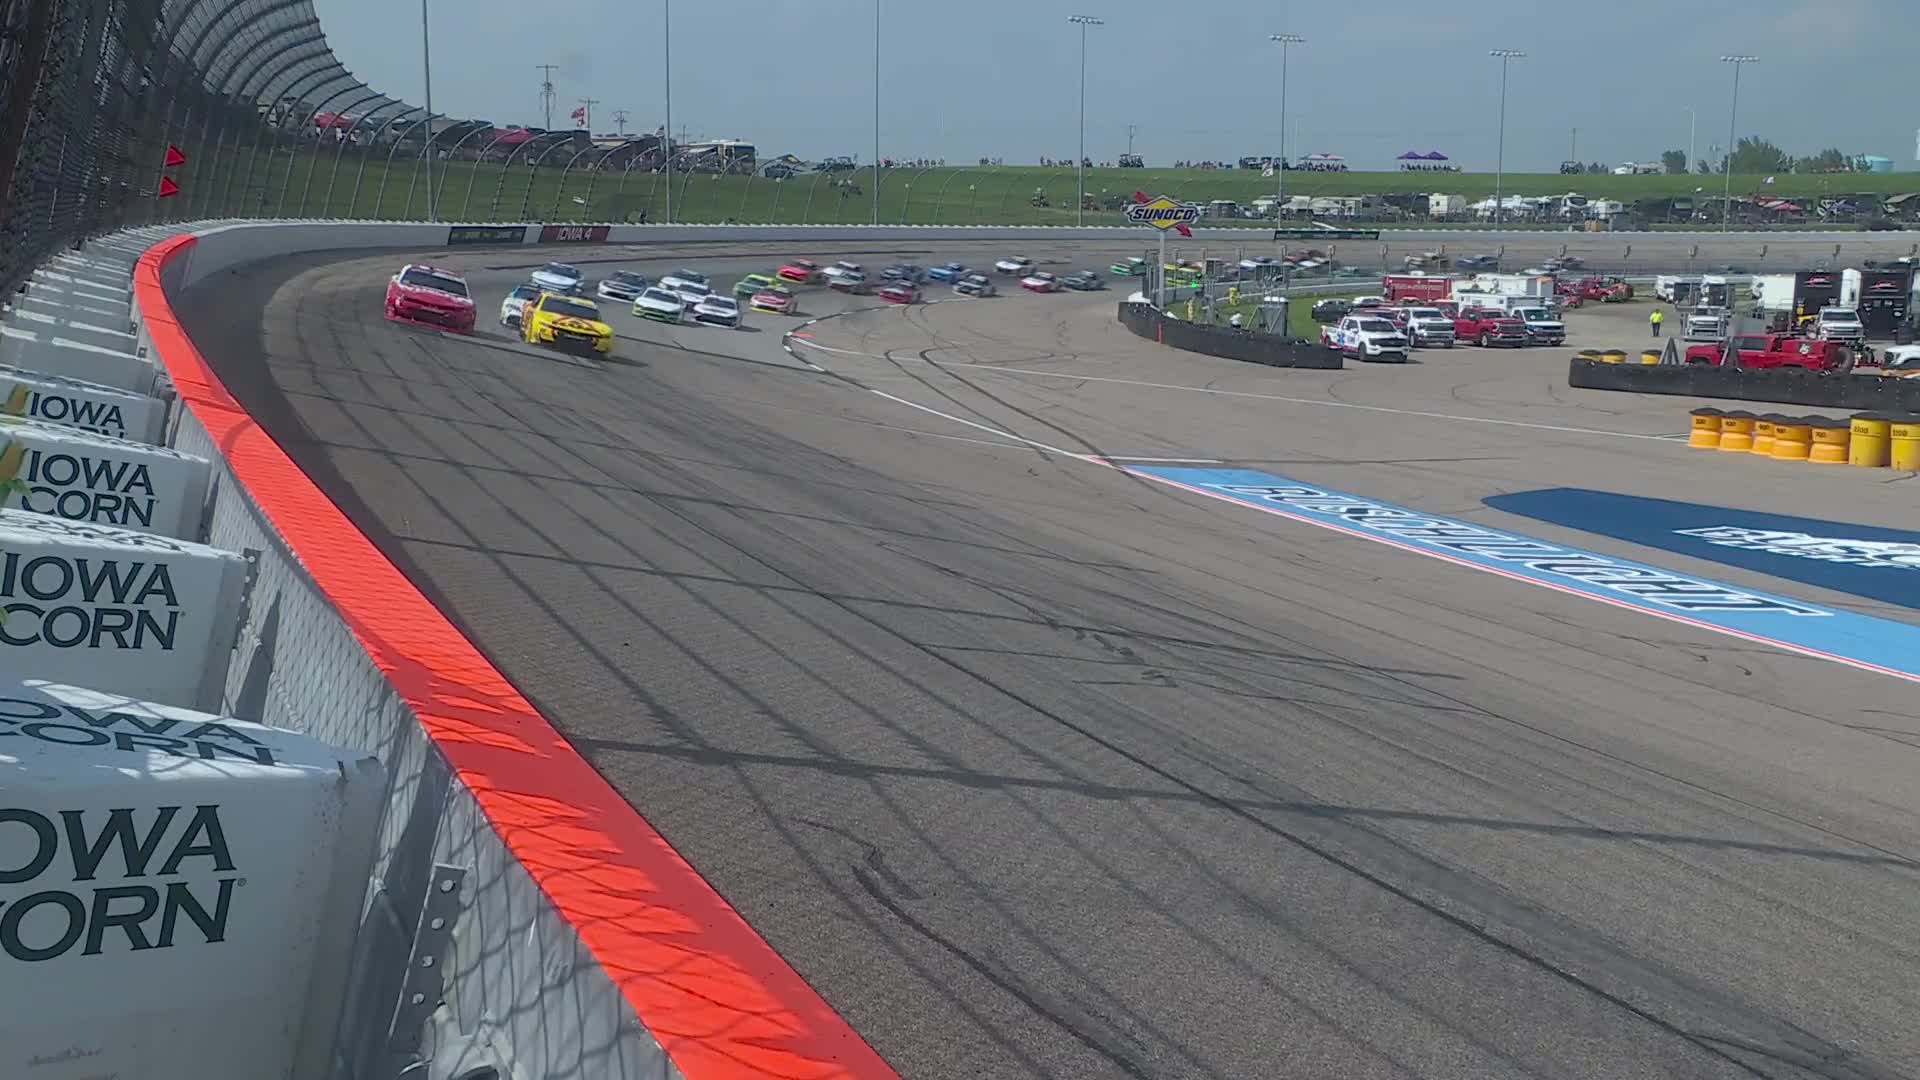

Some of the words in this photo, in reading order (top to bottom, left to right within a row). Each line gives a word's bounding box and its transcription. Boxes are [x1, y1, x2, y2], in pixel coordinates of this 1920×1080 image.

[556, 227, 582, 241] IOWA
[584, 227, 593, 240] 4
[1132, 208, 1194, 220] SUNOCO
[29, 391, 125, 430] IOWA
[26, 450, 155, 496] IOWA
[21, 486, 155, 527] CORN
[1202, 484, 1518, 541] BUSCH
[1415, 538, 1834, 616] LIGHT
[0, 552, 179, 607] IOWA
[0, 602, 179, 650] CORN
[0, 718, 276, 766] ORN
[0, 878, 236, 962] ORN
